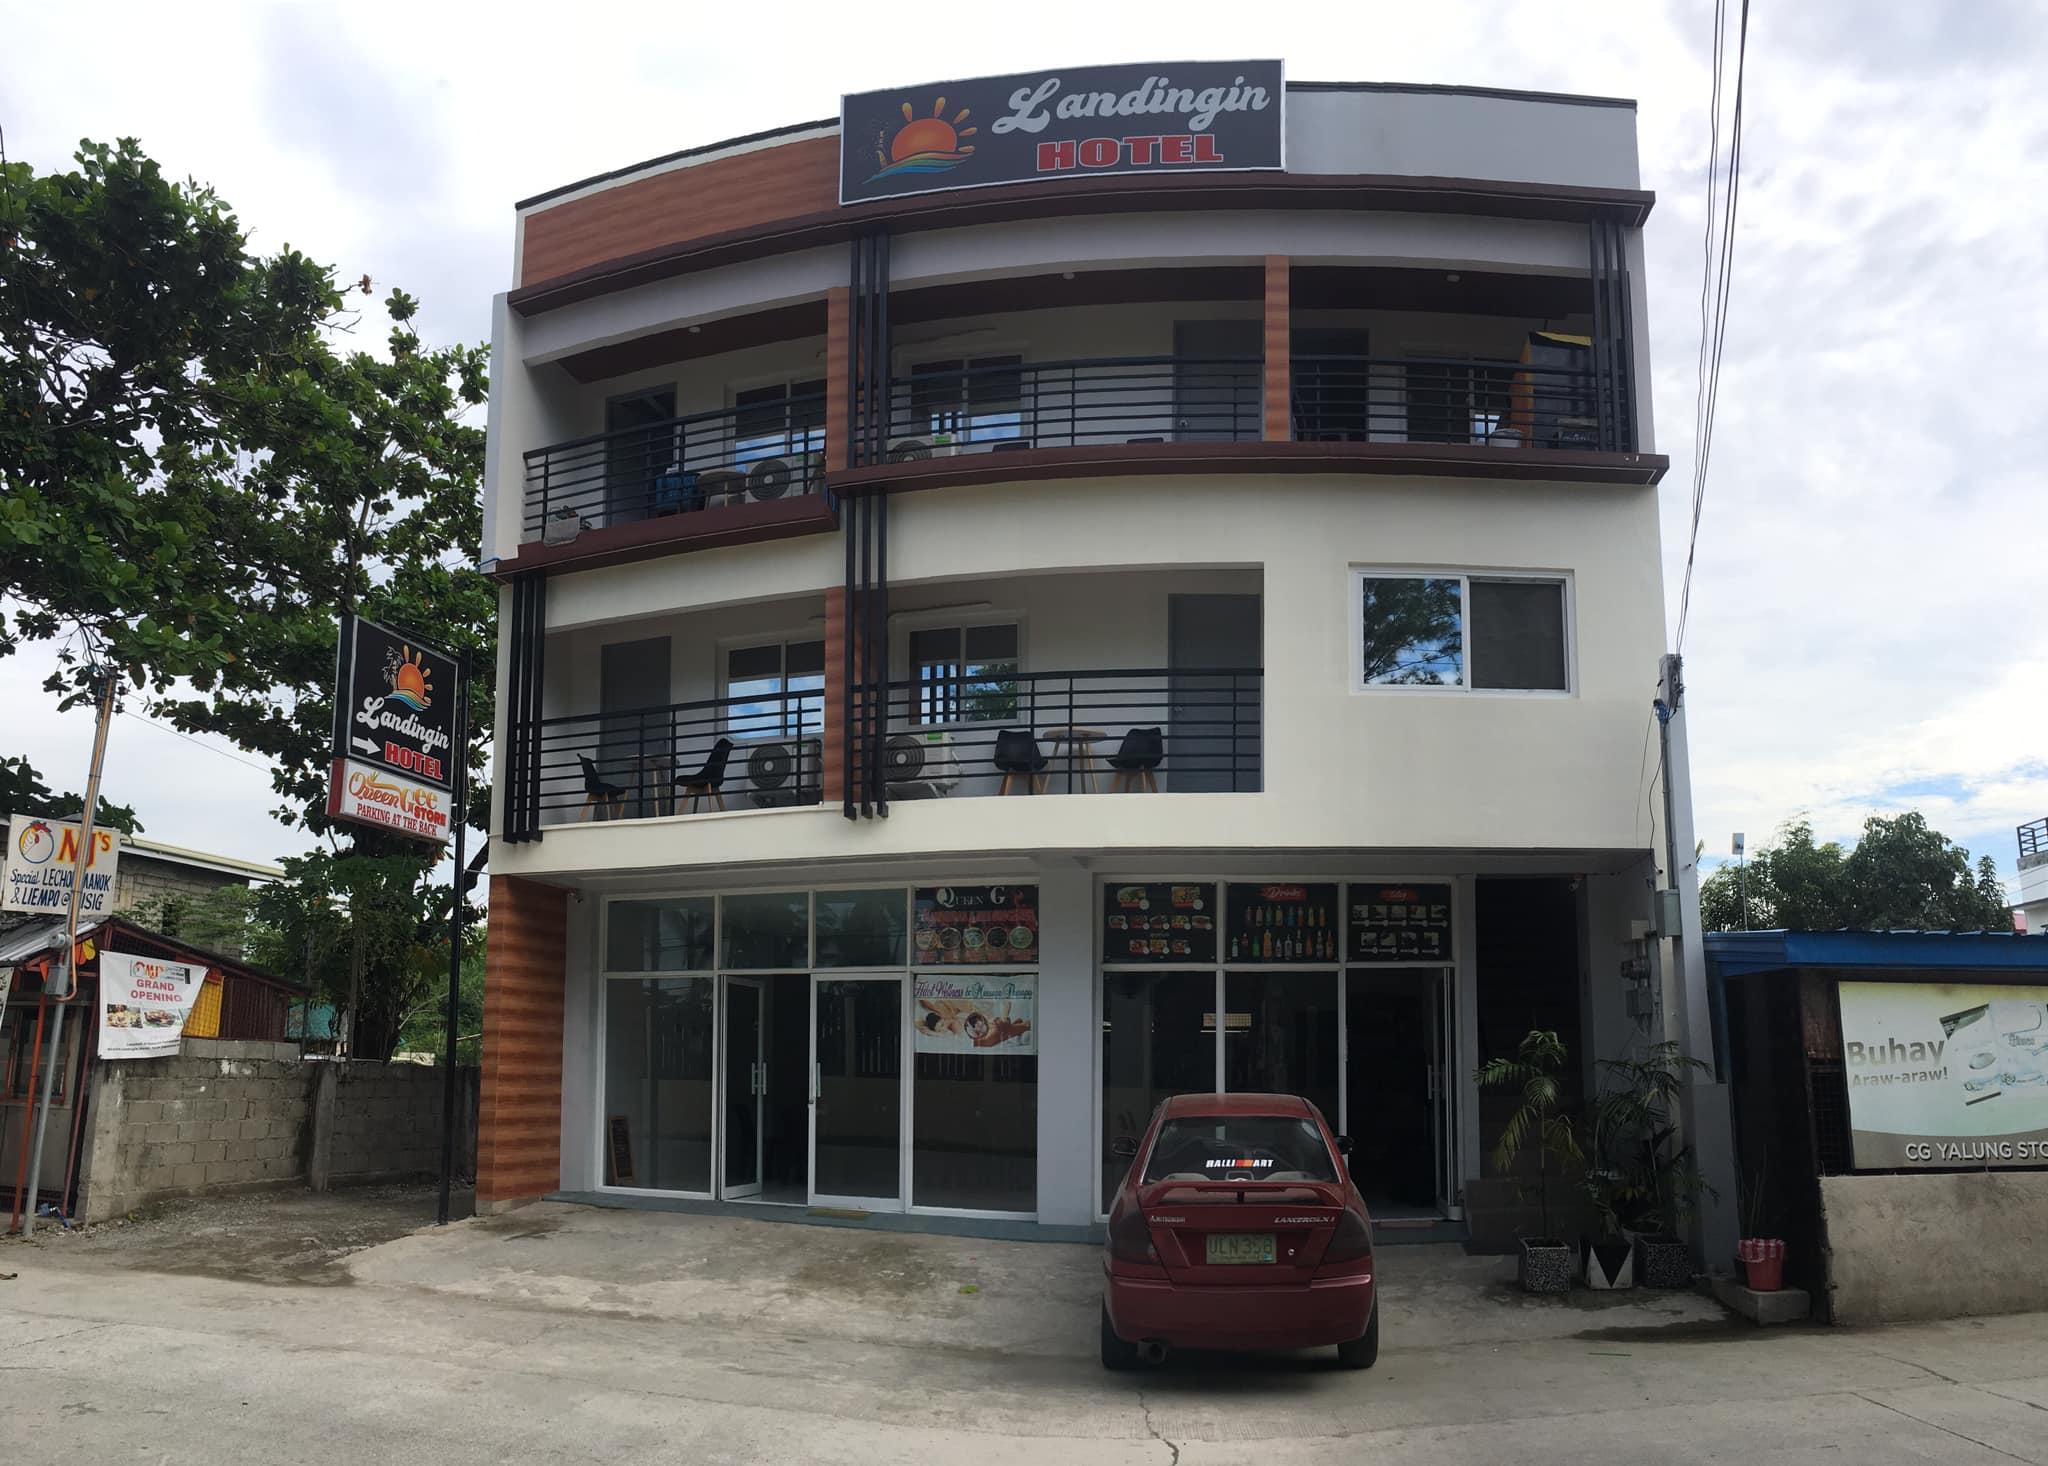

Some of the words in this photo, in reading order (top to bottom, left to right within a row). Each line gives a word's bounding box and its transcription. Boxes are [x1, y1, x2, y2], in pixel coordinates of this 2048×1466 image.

[991, 75, 1270, 134] Landingin
[1036, 134, 1223, 172] HOTEL
[355, 696, 449, 753] Landingin
[384, 741, 443, 780] HOTEL
[349, 771, 399, 808] Queen
[356, 802, 390, 824] PARKING
[391, 812, 403, 826] AT
[403, 816, 419, 831] THE
[419, 821, 437, 837] BACK
[414, 806, 446, 827] STORE
[10, 868, 41, 886] Special
[10, 887, 20, 905] &
[21, 887, 60, 907] LIEMPO
[130, 990, 183, 1003] OPENING
[136, 978, 175, 992] GRAND
[1847, 1037, 1945, 1067] Buhay
[1852, 1066, 1948, 1087] Araw-araw!
[1905, 1143, 1931, 1160] CG
[1936, 1141, 2012, 1160] YALUNG
